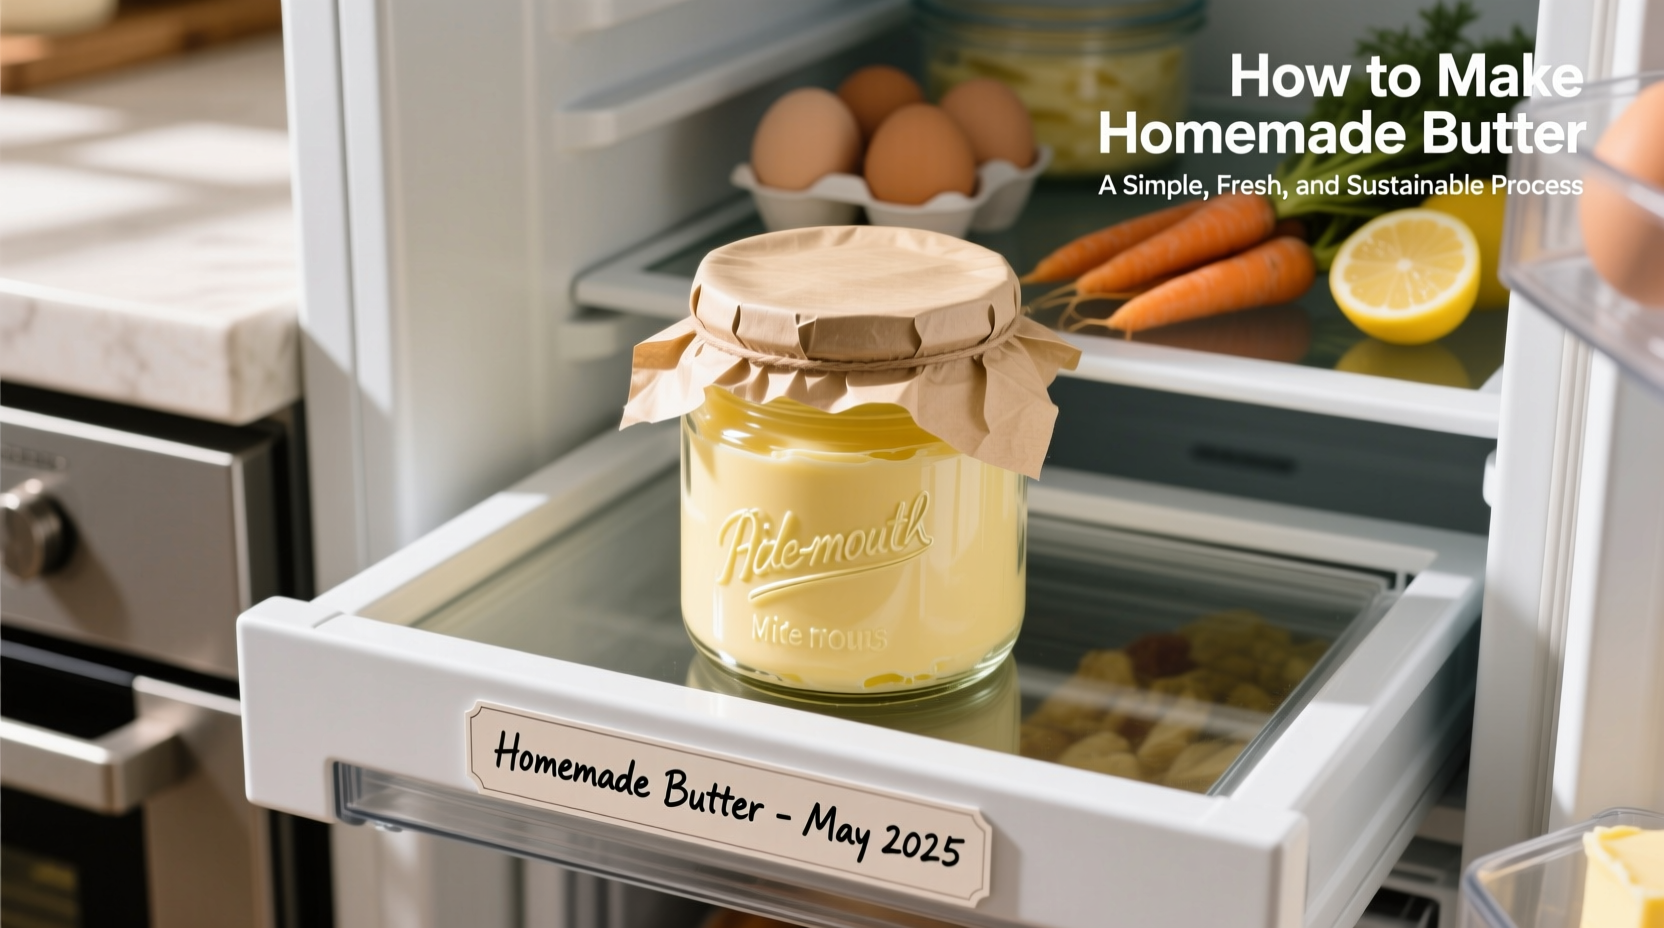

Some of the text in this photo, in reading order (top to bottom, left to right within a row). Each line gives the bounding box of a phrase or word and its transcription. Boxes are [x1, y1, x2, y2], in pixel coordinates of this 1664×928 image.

[494, 730, 651, 798] Homemade
[663, 768, 765, 822] Butter
[802, 801, 871, 864] May
[881, 824, 965, 867] 2025
